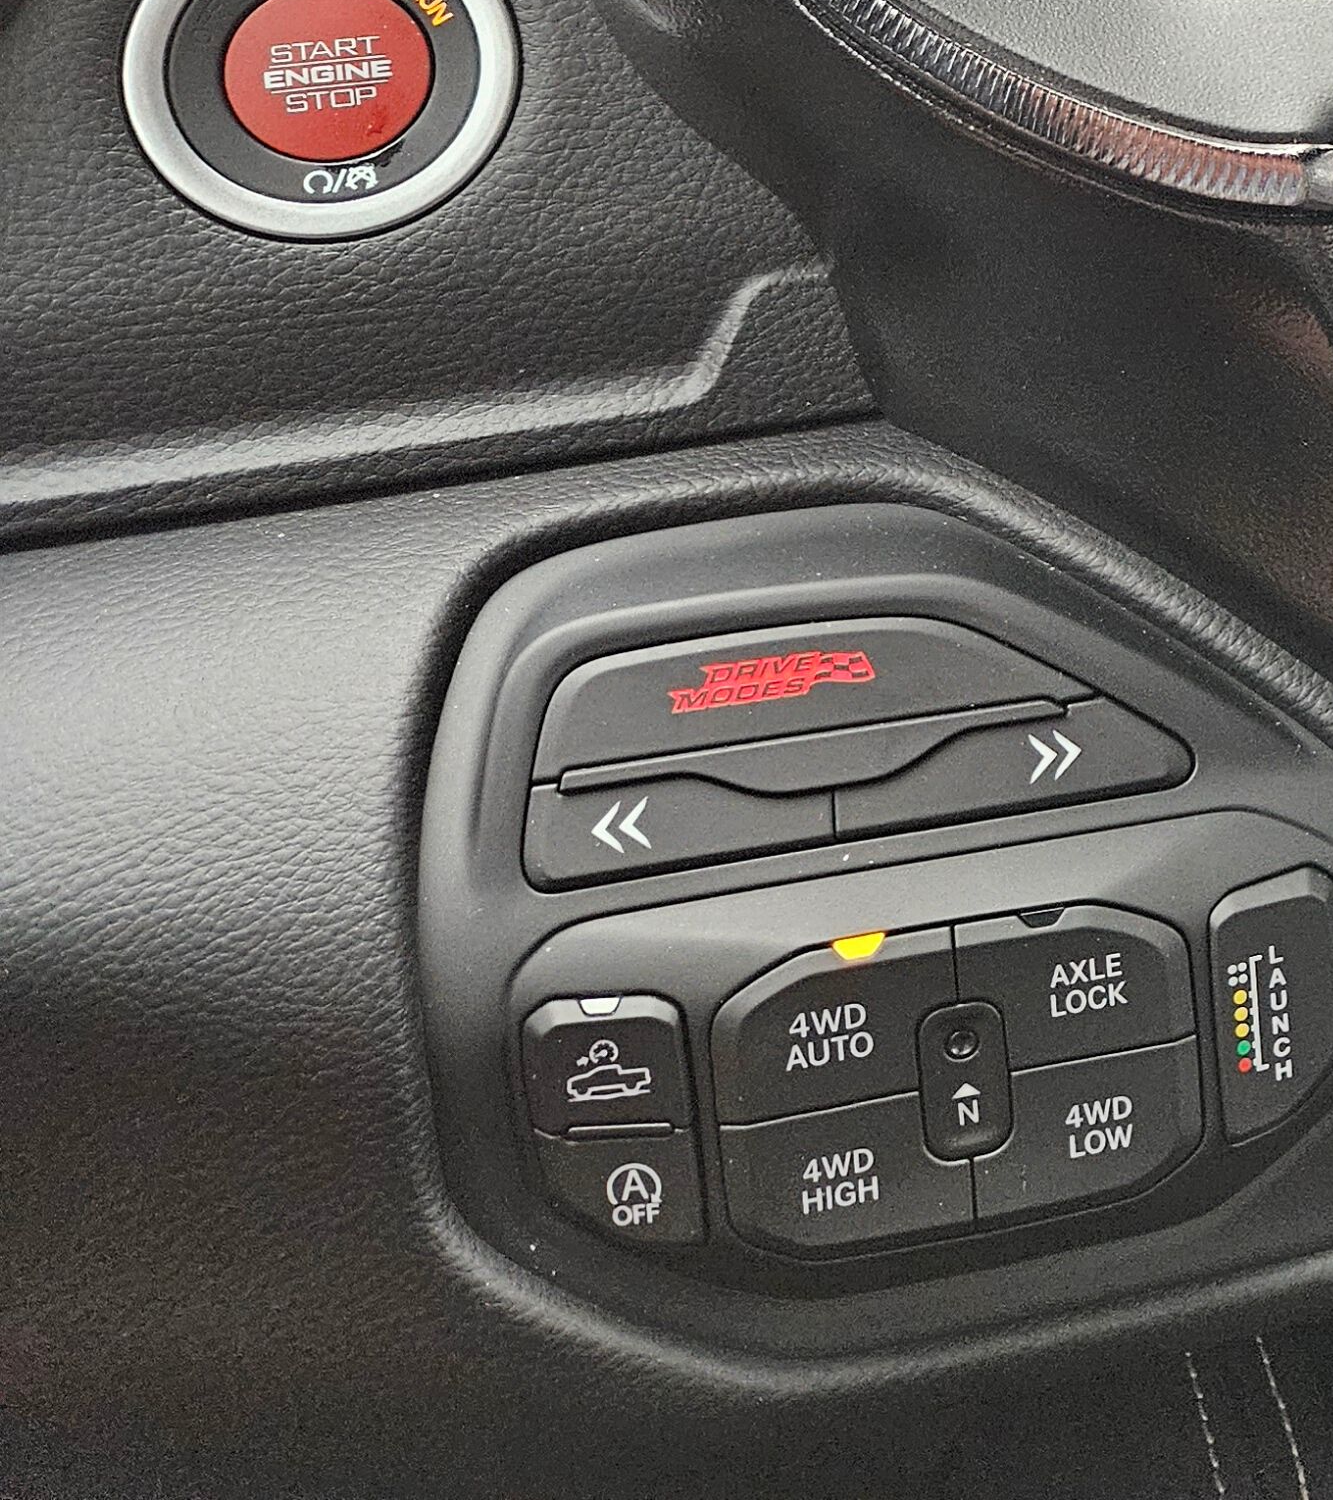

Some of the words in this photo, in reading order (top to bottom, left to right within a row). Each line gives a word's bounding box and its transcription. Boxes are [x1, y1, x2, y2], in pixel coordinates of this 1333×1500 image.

[269, 35, 381, 63] START
[263, 59, 393, 89] ENGINE
[285, 85, 378, 114] STOP
[706, 653, 817, 685] DRIVE
[674, 676, 806, 710] MODES
[1050, 953, 1123, 988] AXLE
[1050, 981, 1128, 1018] LOCK
[1268, 945, 1293, 1081] LAUNCH
[789, 1003, 867, 1038] 4WD
[785, 1031, 875, 1072] AUTO
[957, 1099, 980, 1126] N
[1064, 1096, 1133, 1129] 4WD
[1068, 1123, 1133, 1159] LOW
[802, 1148, 875, 1183] 4WD
[801, 1176, 880, 1215] HIGH
[612, 1202, 660, 1227] OFF
